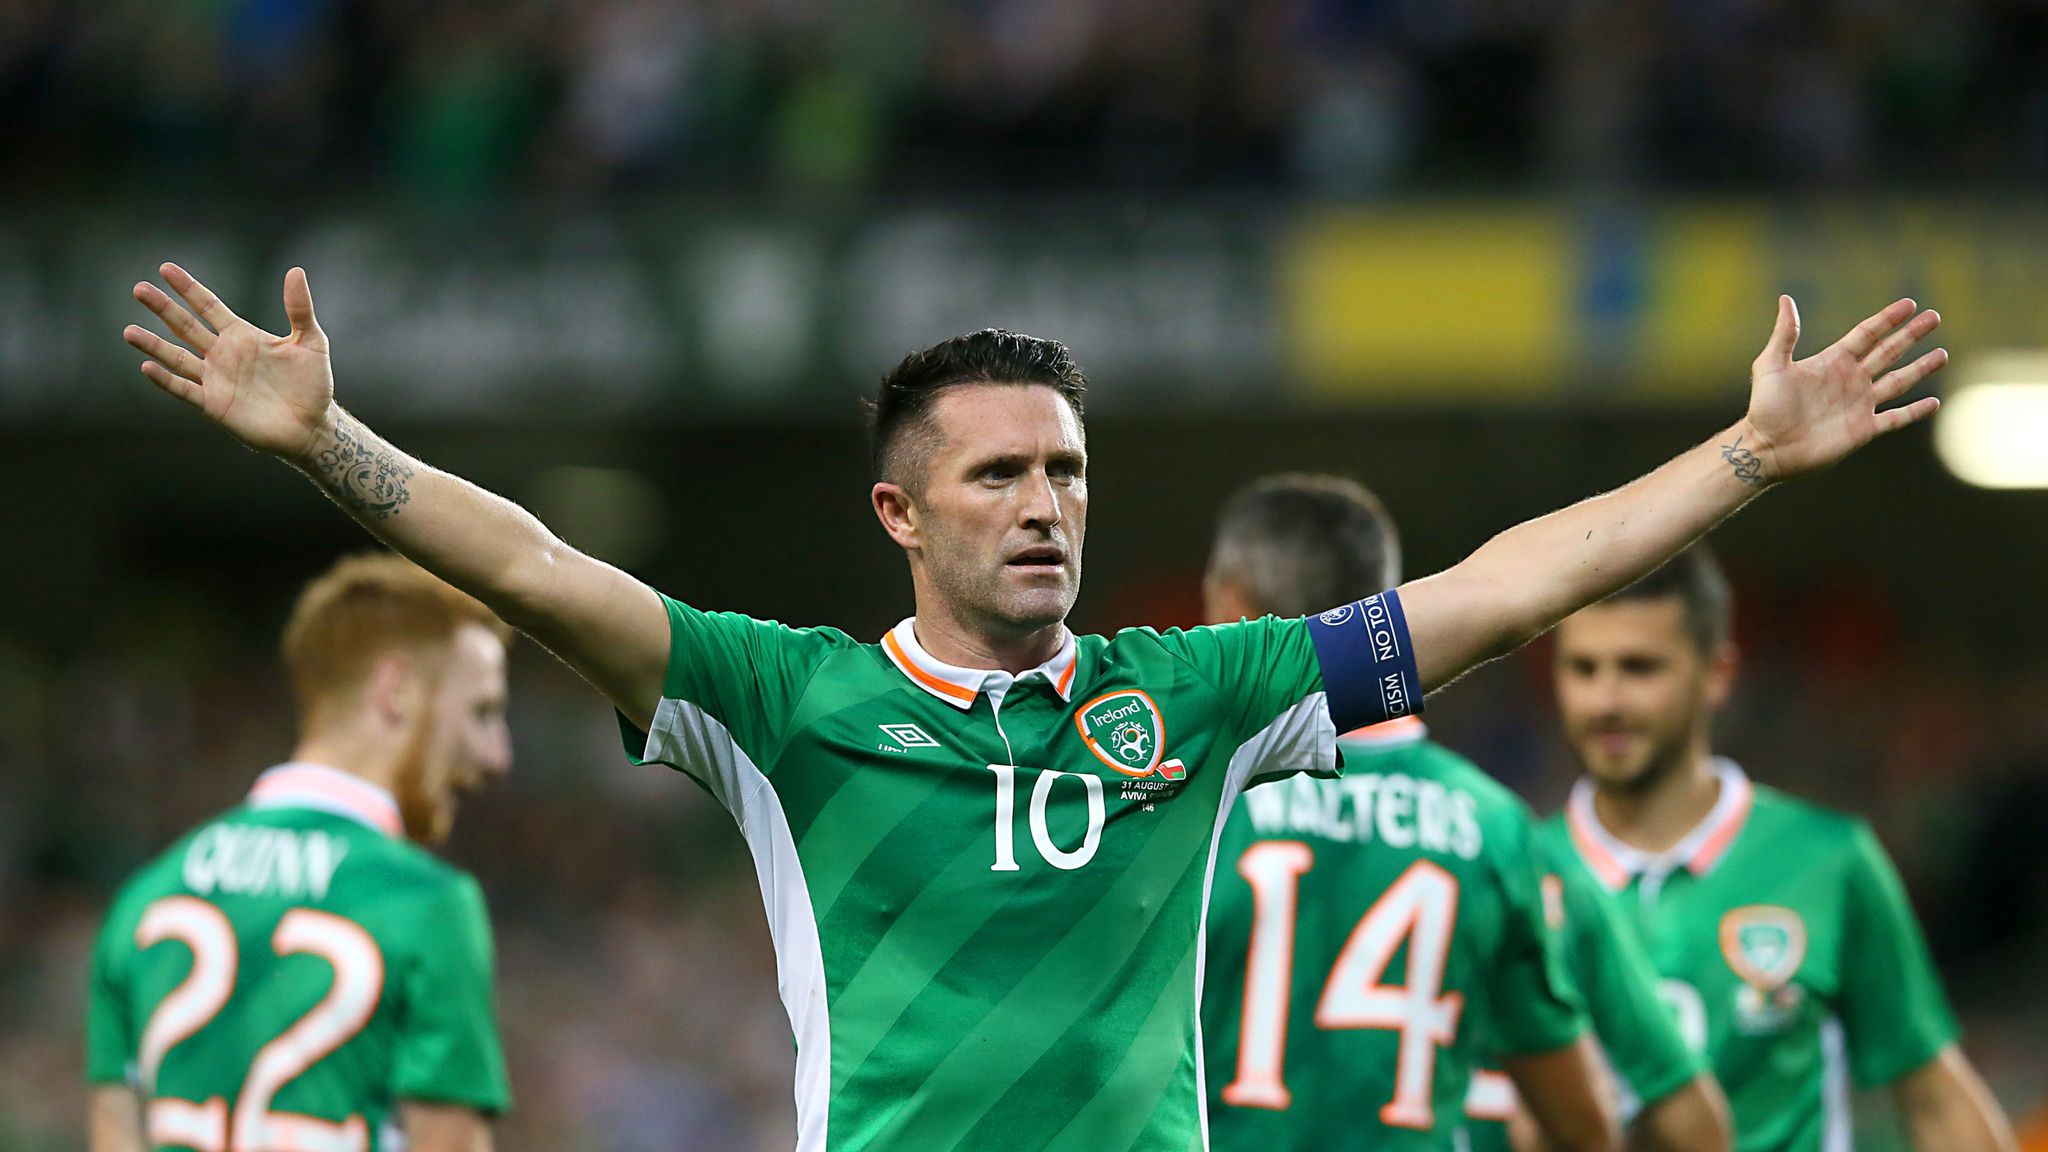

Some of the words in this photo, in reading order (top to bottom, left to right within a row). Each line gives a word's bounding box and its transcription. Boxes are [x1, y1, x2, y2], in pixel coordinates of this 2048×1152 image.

[1367, 606, 1386, 629] TO
[1375, 630, 1394, 661] NO
[1090, 699, 1141, 727] Ireland
[1384, 672, 1406, 716] CISM
[1120, 791, 1147, 801] AVIVA
[1121, 781, 1132, 789] 31
[1133, 781, 1170, 791] AUGUST
[986, 763, 1106, 871] 10
[1245, 770, 1483, 860] WALTERS
[182, 822, 330, 899] QUINN
[1221, 840, 1465, 1131] 14
[134, 894, 387, 1152] 22
